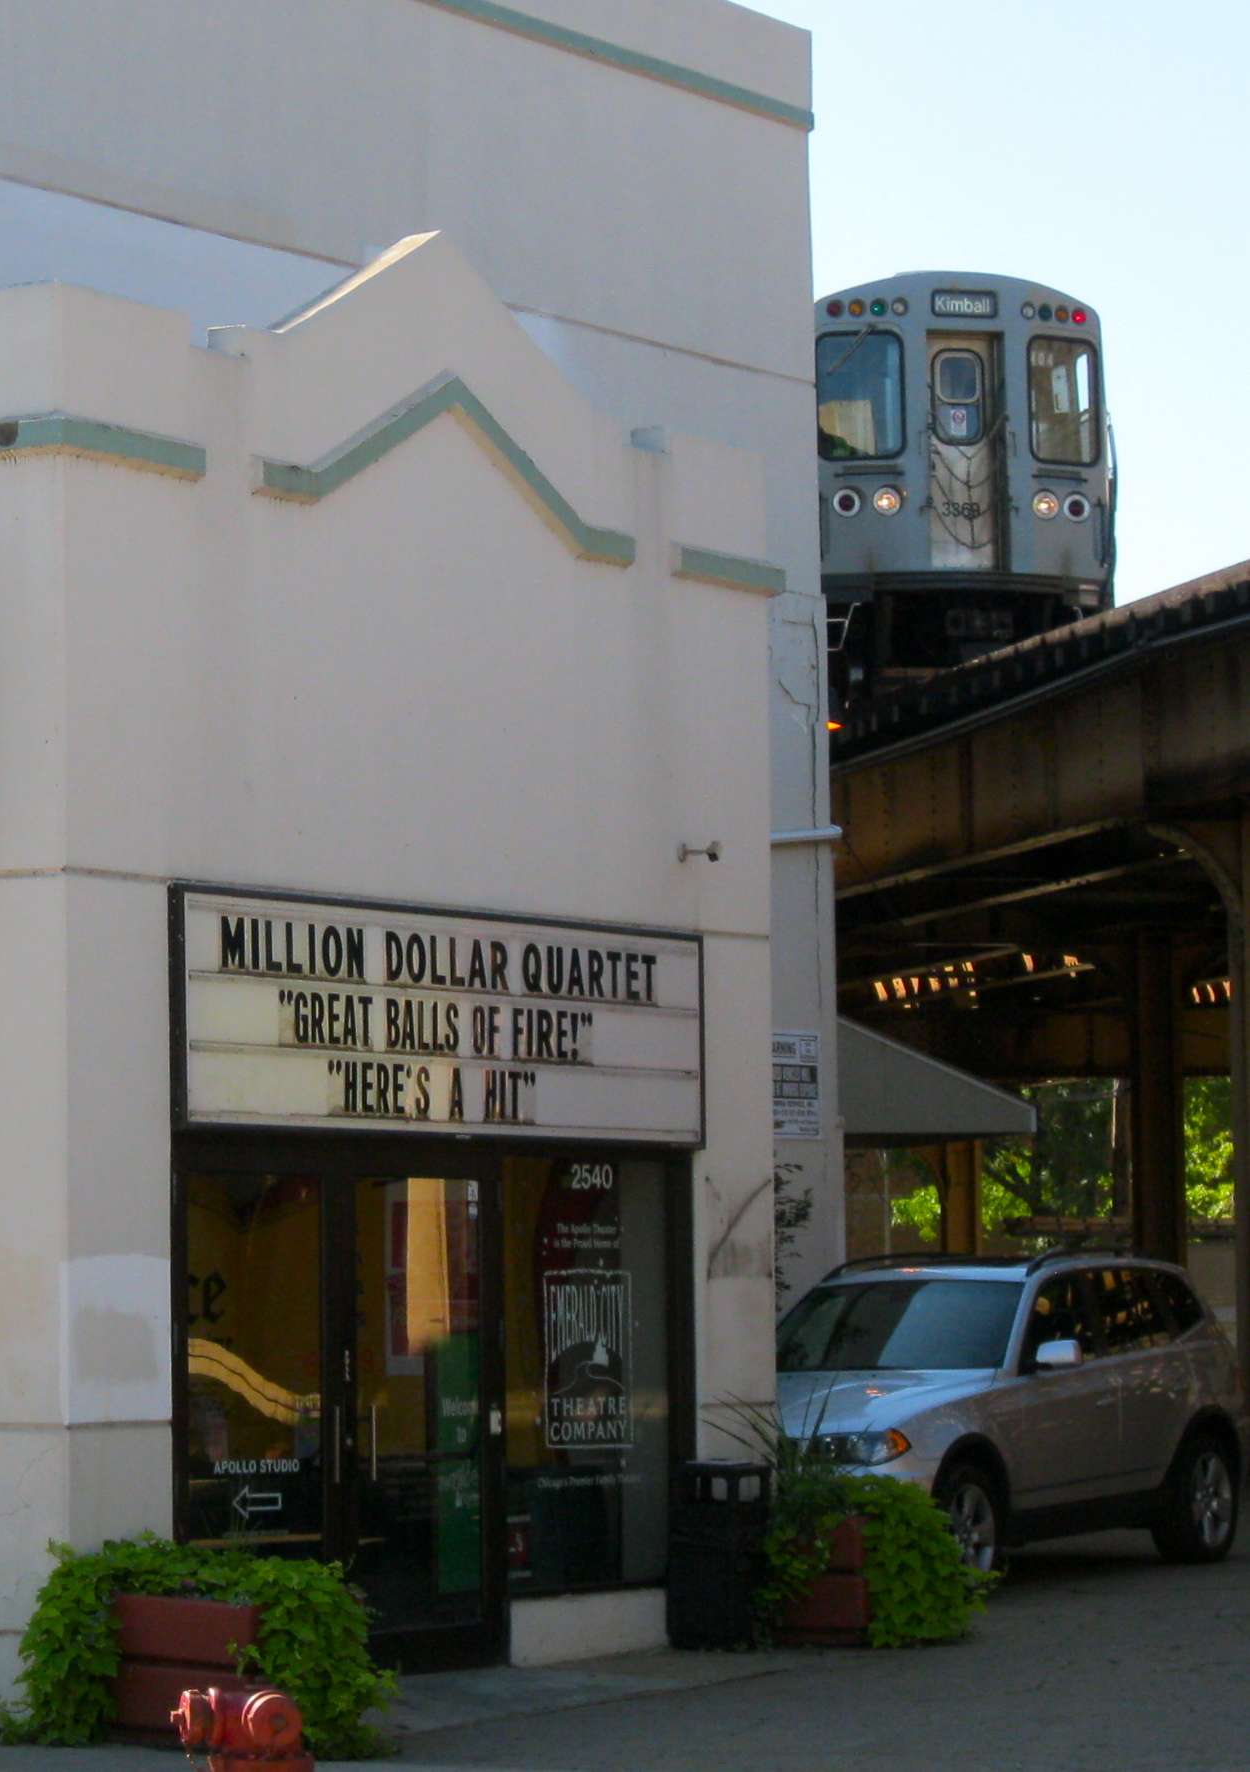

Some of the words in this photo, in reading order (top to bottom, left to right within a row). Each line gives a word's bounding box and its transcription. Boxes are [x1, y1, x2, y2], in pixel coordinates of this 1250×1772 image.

[935, 296, 990, 313] Kimball
[221, 916, 364, 979] MILLION
[385, 929, 508, 991] DOLLAR
[522, 943, 657, 1002] QUARTET
[279, 989, 373, 1047] "GREAT
[385, 998, 460, 1054] BALLS
[473, 1004, 500, 1056] OF
[512, 1007, 593, 1060] FIRE!"
[327, 1059, 431, 1117] "HERE'S
[451, 1067, 464, 1120] A
[485, 1068, 537, 1121] HIT"
[571, 1164, 613, 1190] 2540
[557, 1223, 569, 1233] The
[561, 1238, 572, 1248] the
[550, 1283, 597, 1364] EMERALD
[599, 1283, 624, 1357] CITY
[552, 1397, 627, 1416] THEATRE
[551, 1419, 628, 1442] COMPANY
[214, 1460, 256, 1474] APOLLO
[259, 1459, 300, 1474] STUDIO
